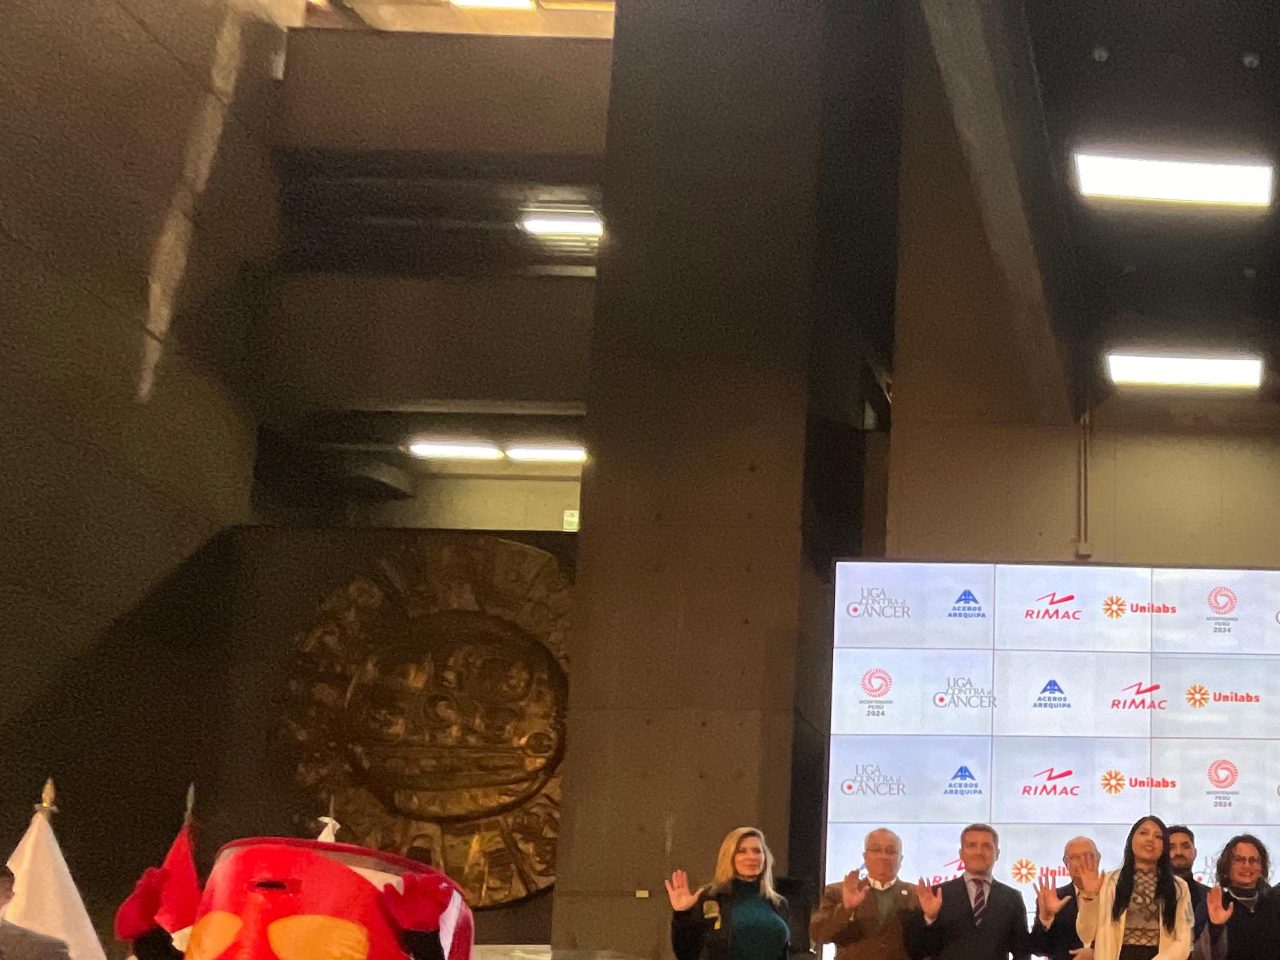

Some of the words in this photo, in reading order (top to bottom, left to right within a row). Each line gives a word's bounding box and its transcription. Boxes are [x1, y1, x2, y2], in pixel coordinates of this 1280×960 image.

[860, 587, 887, 598] LIGA
[1130, 603, 1177, 614] Unilabs
[1024, 608, 1083, 621] RIMAC
[947, 677, 973, 688] LIGA
[1213, 692, 1260, 703] Unilabs
[1111, 698, 1168, 710] RIMAC
[855, 764, 881, 775] LIGA
[1129, 777, 1177, 788] Unilabs
[1021, 784, 1081, 796] RIMAC
